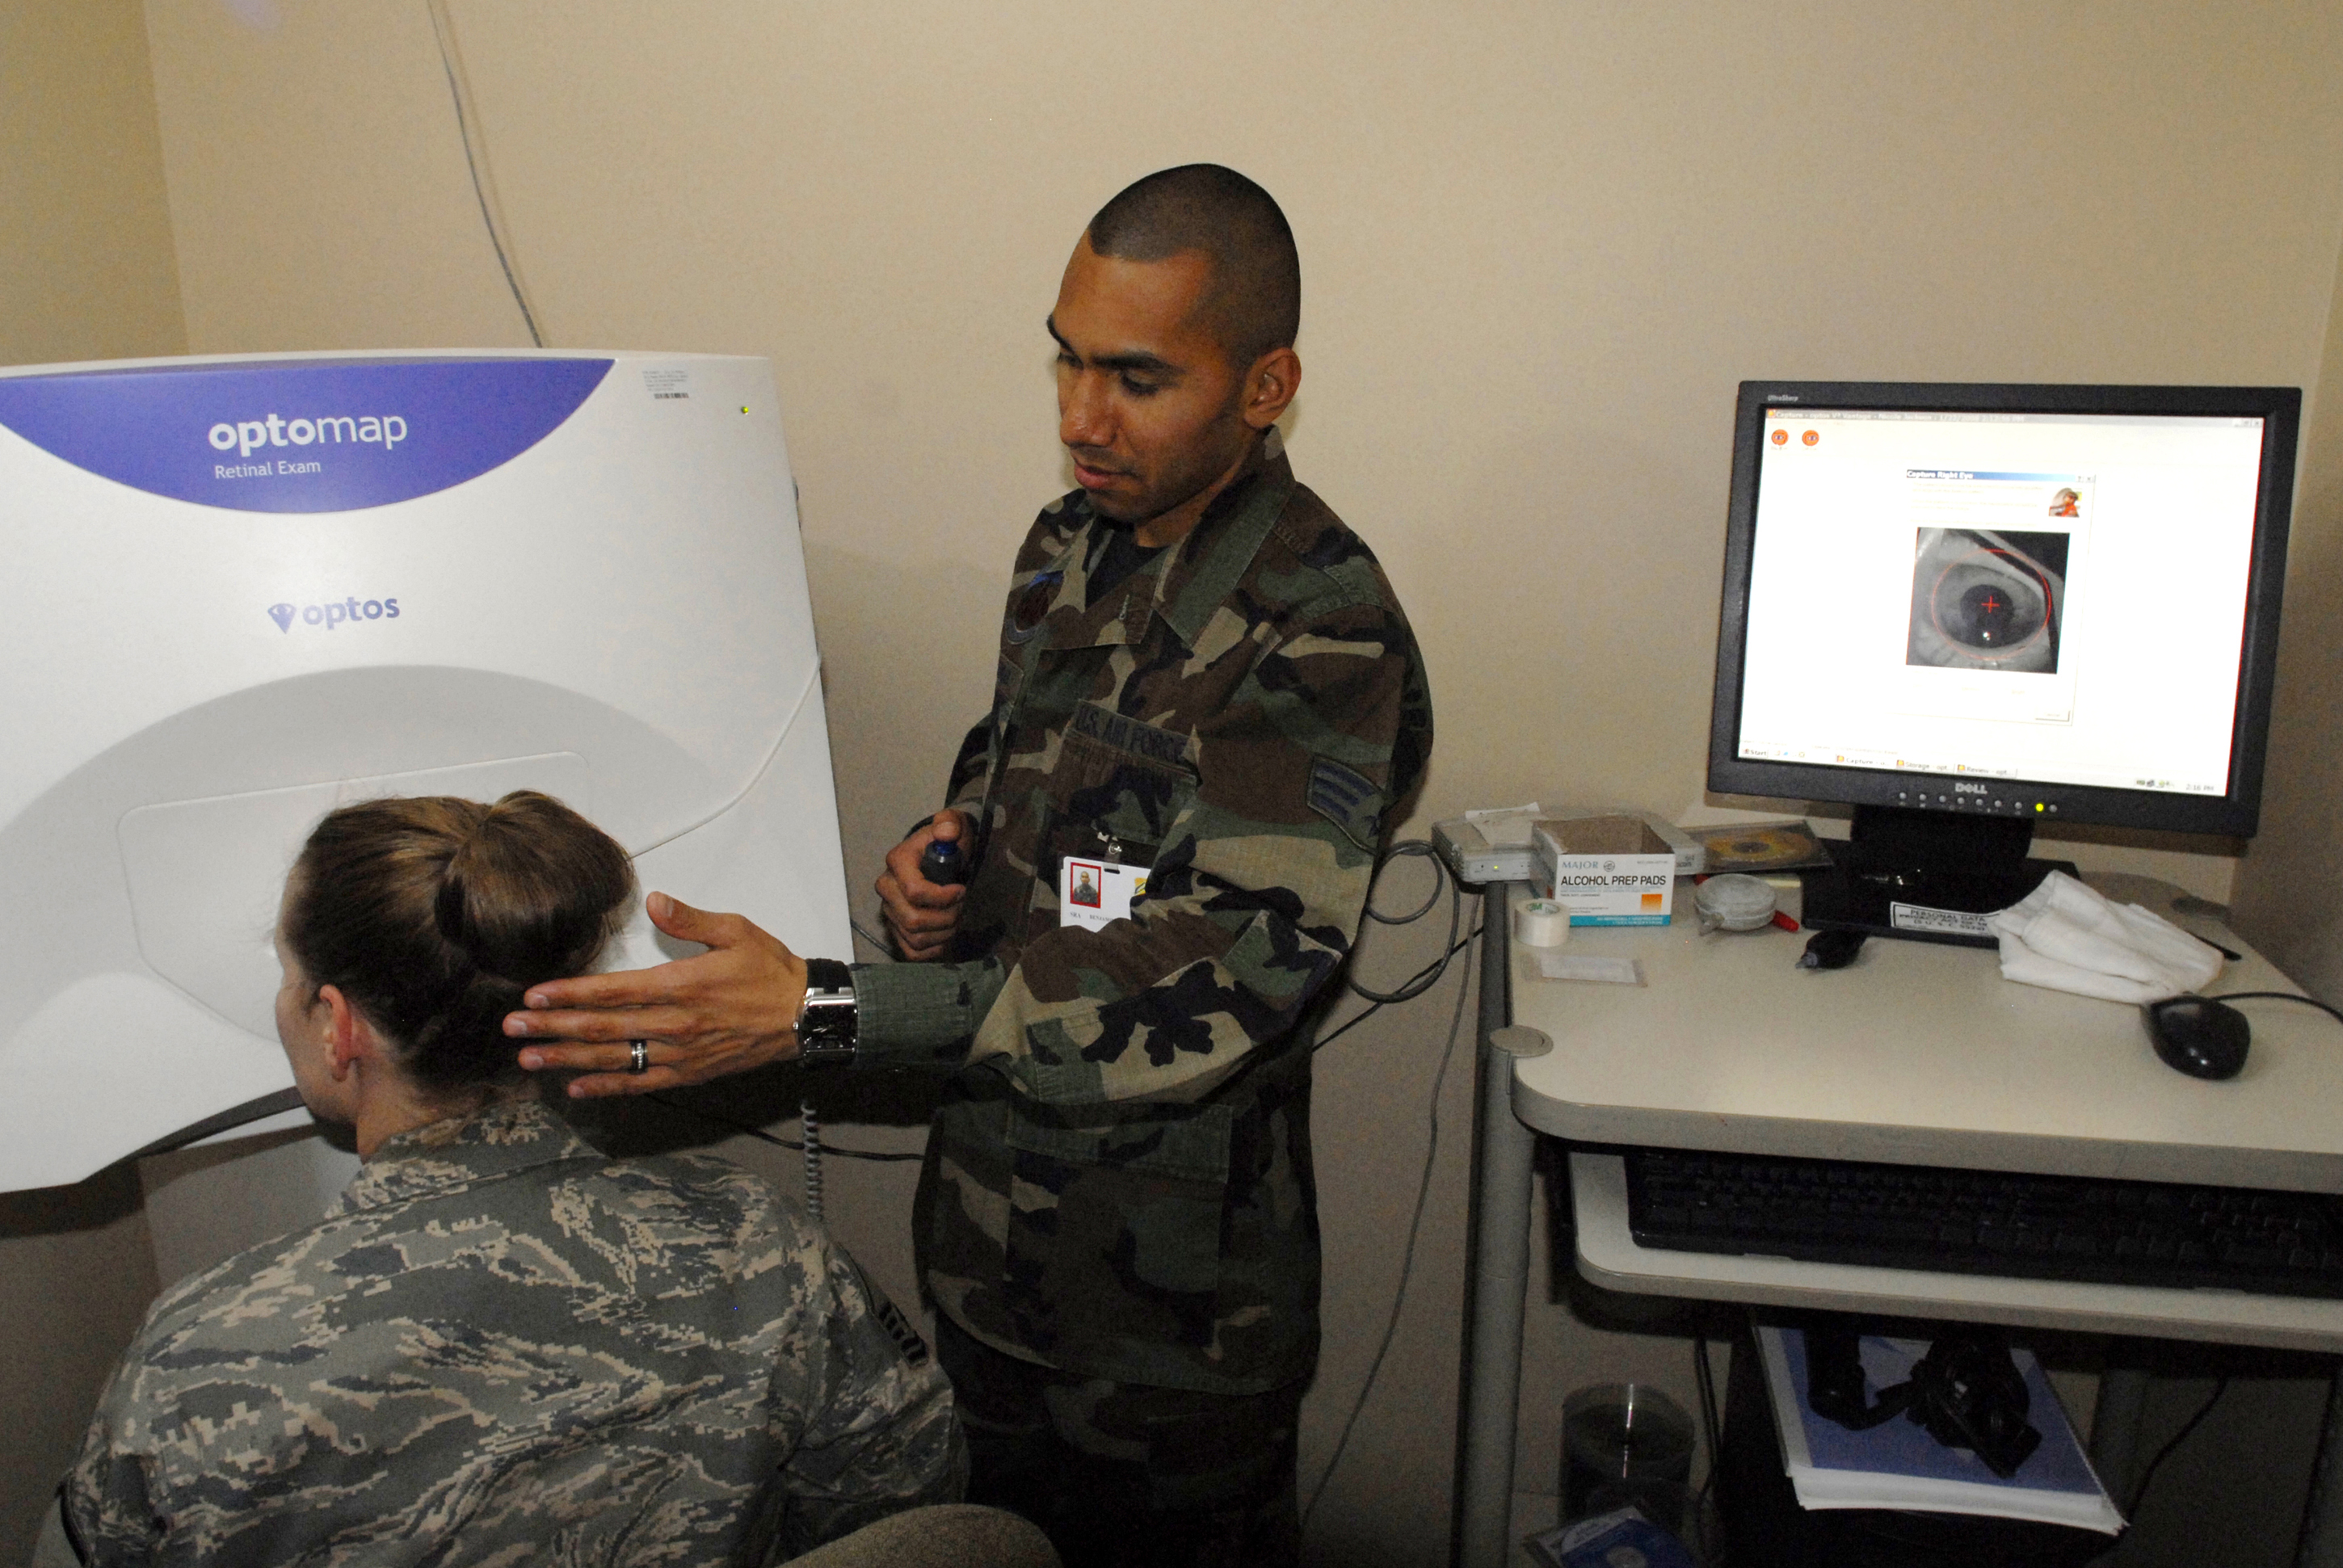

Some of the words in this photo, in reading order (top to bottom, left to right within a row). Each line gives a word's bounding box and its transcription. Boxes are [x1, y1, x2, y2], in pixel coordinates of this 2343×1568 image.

[208, 413, 407, 456] optomap
[214, 461, 272, 479] Retinal
[278, 460, 321, 475] Exam
[1907, 470, 1936, 479] Capture
[1937, 471, 1958, 480] Right
[1959, 472, 1974, 480] Eye
[301, 595, 401, 630] optos
[1846, 757, 1874, 767] Capture
[1954, 782, 1988, 794] DELL
[1562, 860, 1599, 870] MAJOR
[1560, 876, 1609, 885] ALCOHOL
[1611, 876, 1638, 885] PREP
[1640, 875, 1667, 885] PADS
[1911, 910, 1957, 919] PERSONAL
